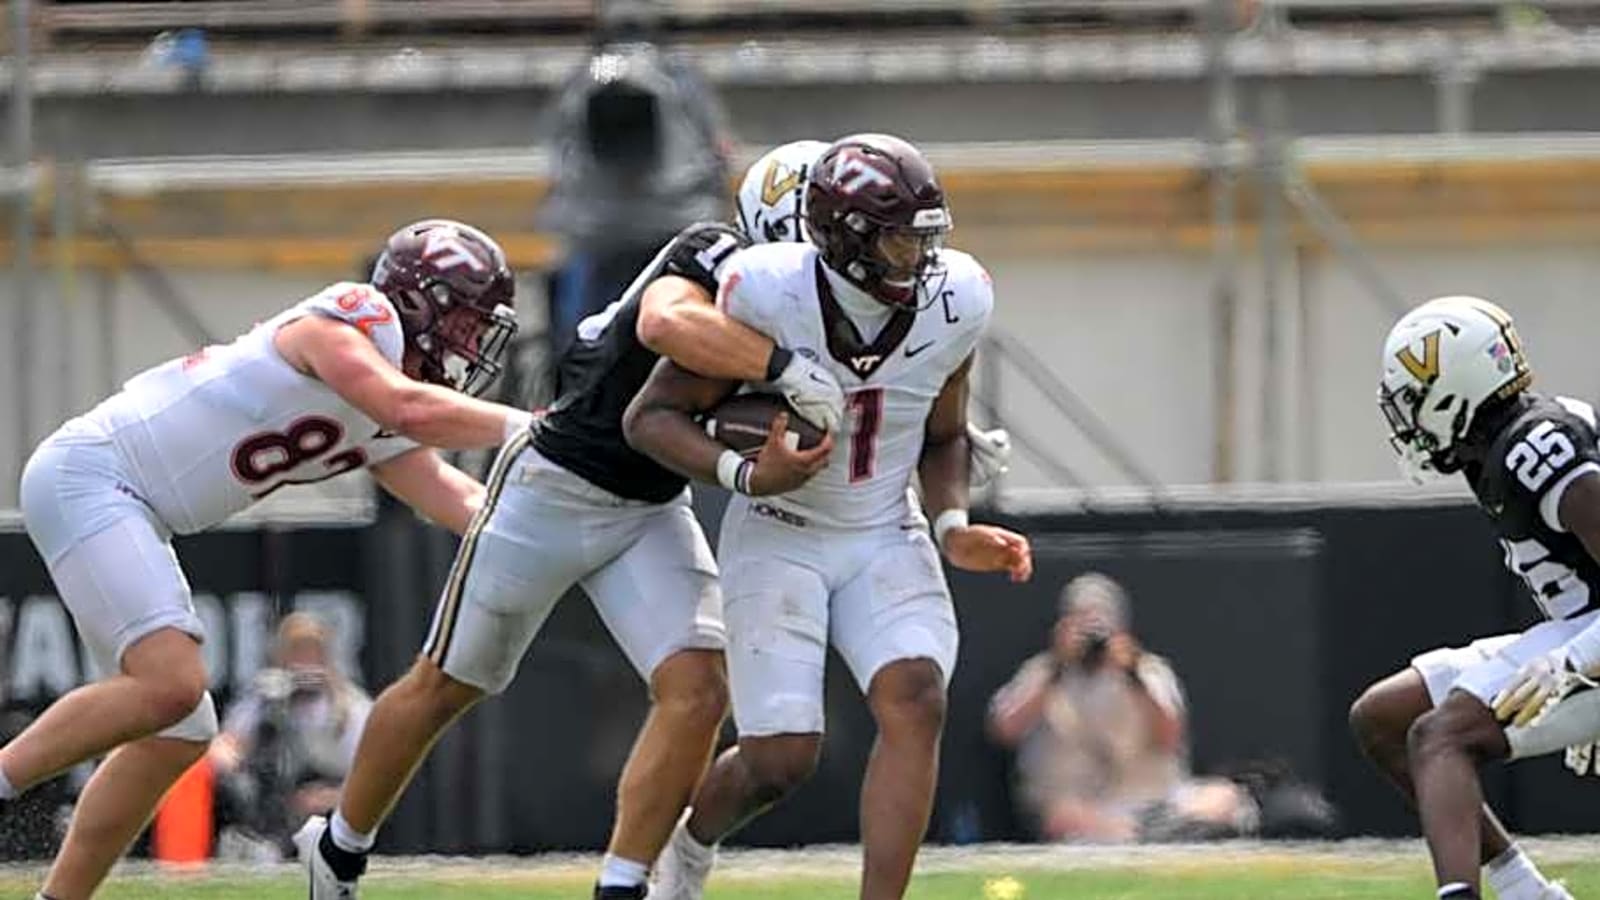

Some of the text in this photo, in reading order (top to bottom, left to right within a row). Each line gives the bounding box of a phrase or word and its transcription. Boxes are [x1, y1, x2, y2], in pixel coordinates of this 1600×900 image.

[761, 159, 798, 208] V
[941, 290, 960, 324] C
[850, 355, 881, 371] VT
[1395, 329, 1441, 384] V
[842, 385, 885, 486] 1
[1505, 420, 1576, 492] 25
